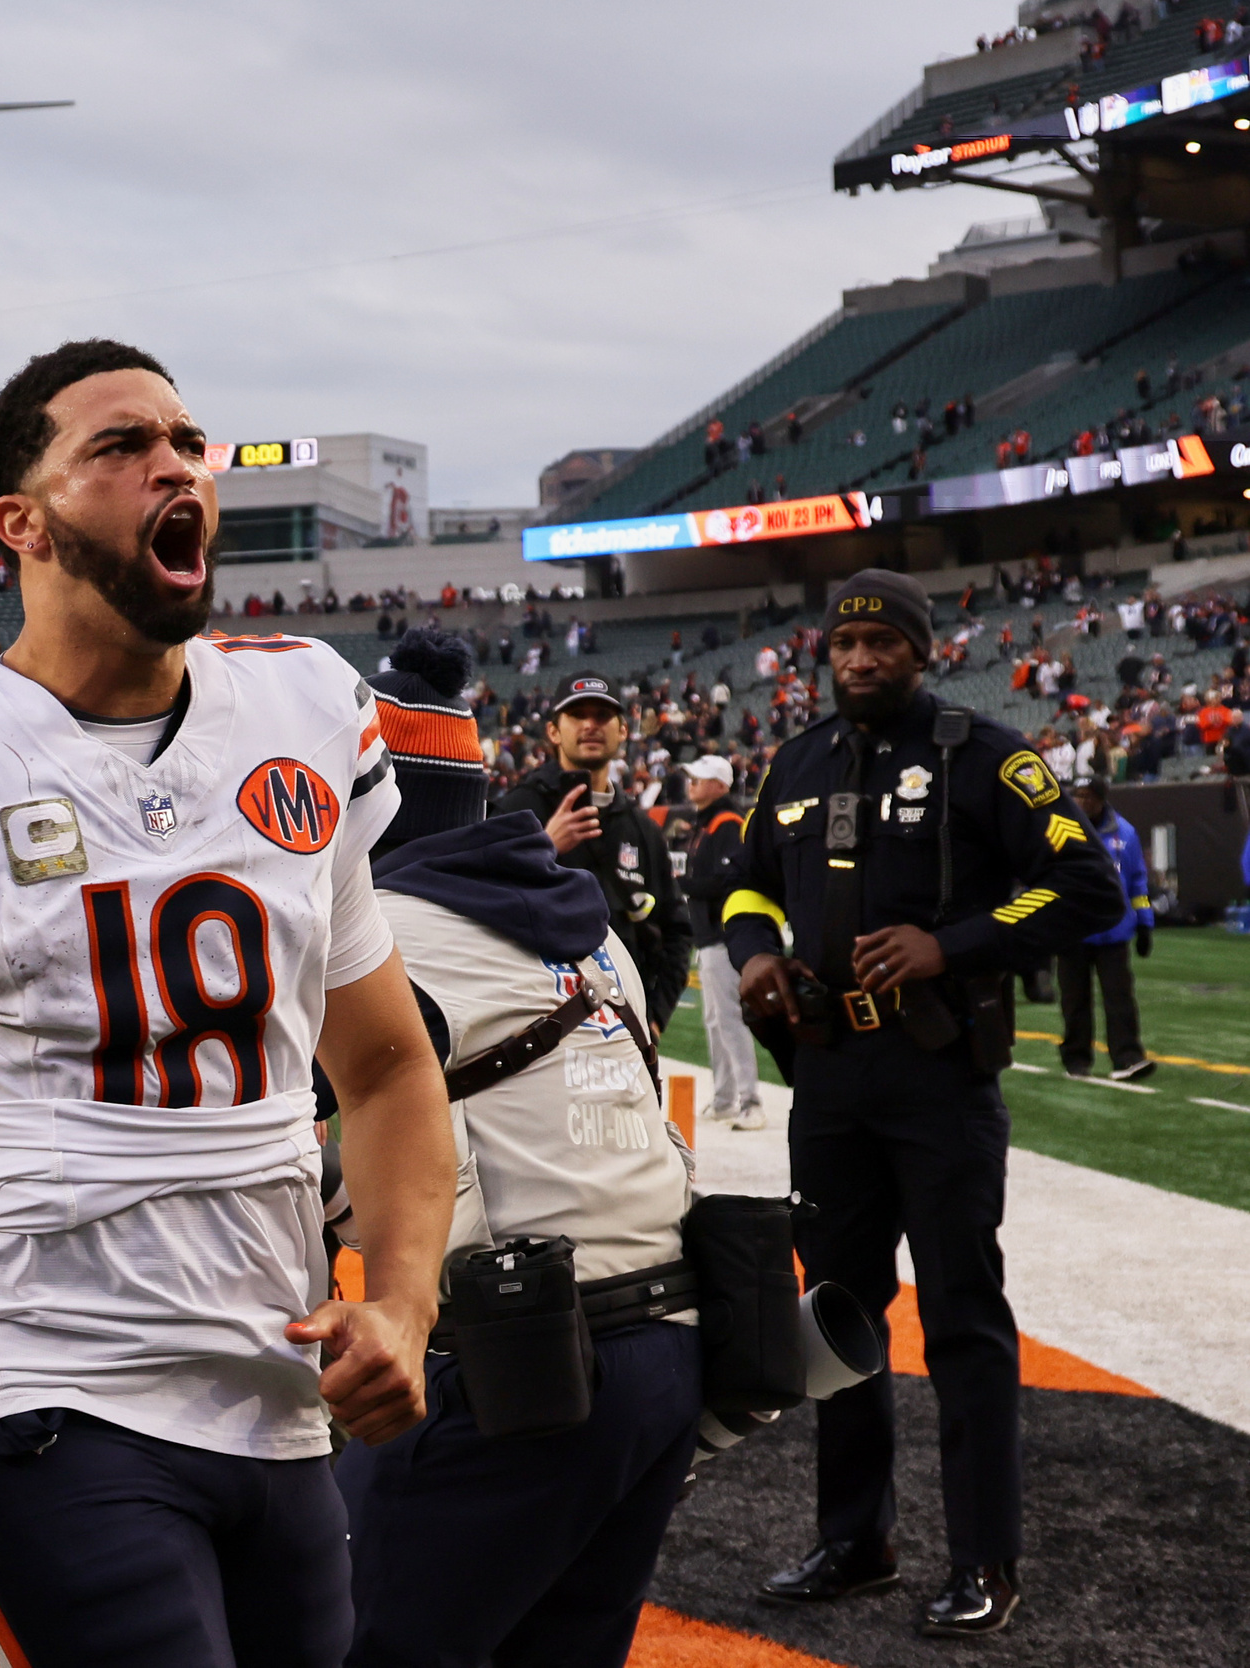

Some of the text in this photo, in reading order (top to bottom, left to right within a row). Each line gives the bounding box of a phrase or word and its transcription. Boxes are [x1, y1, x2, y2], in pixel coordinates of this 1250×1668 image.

[892, 134, 1011, 175] Paycor STADIUM
[240, 443, 283, 467] 0:00
[767, 503, 836, 529] NOV 23 1PM
[549, 522, 680, 556] ticketmaster
[838, 596, 883, 614] CPD
[7, 801, 78, 861] C
[148, 811, 174, 831] NFL
[82, 872, 276, 1108] 18
[567, 1103, 650, 1150] CHI-010
